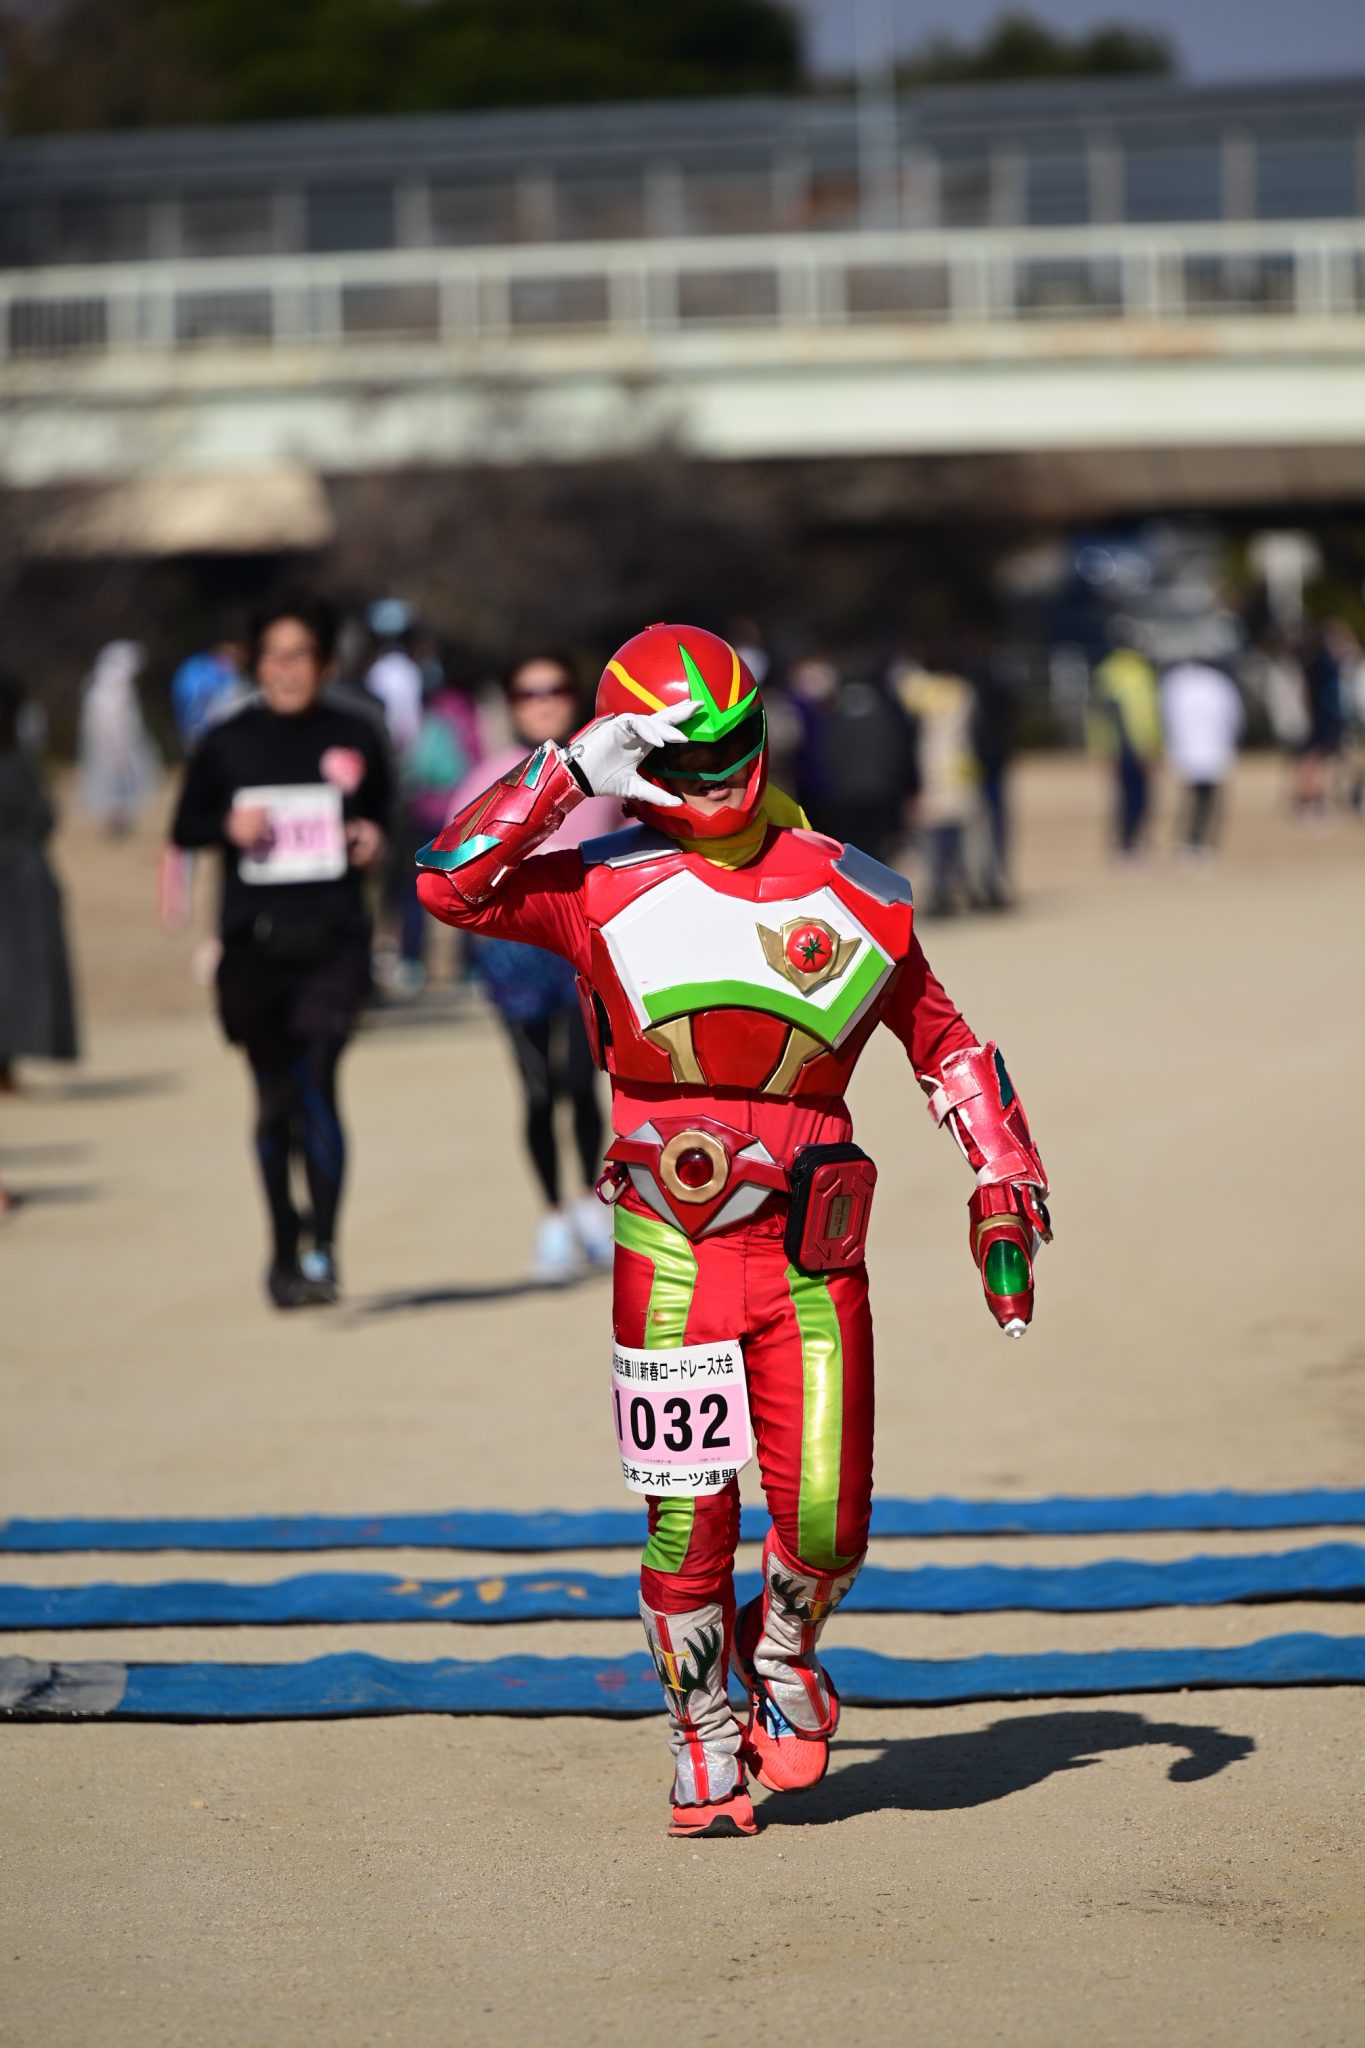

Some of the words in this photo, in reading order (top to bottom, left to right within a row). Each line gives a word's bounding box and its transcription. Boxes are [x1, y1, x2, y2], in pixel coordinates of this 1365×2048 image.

[613, 1352, 734, 1382] 回武庫川新春ロードレース大会
[614, 1389, 731, 1452] 1032
